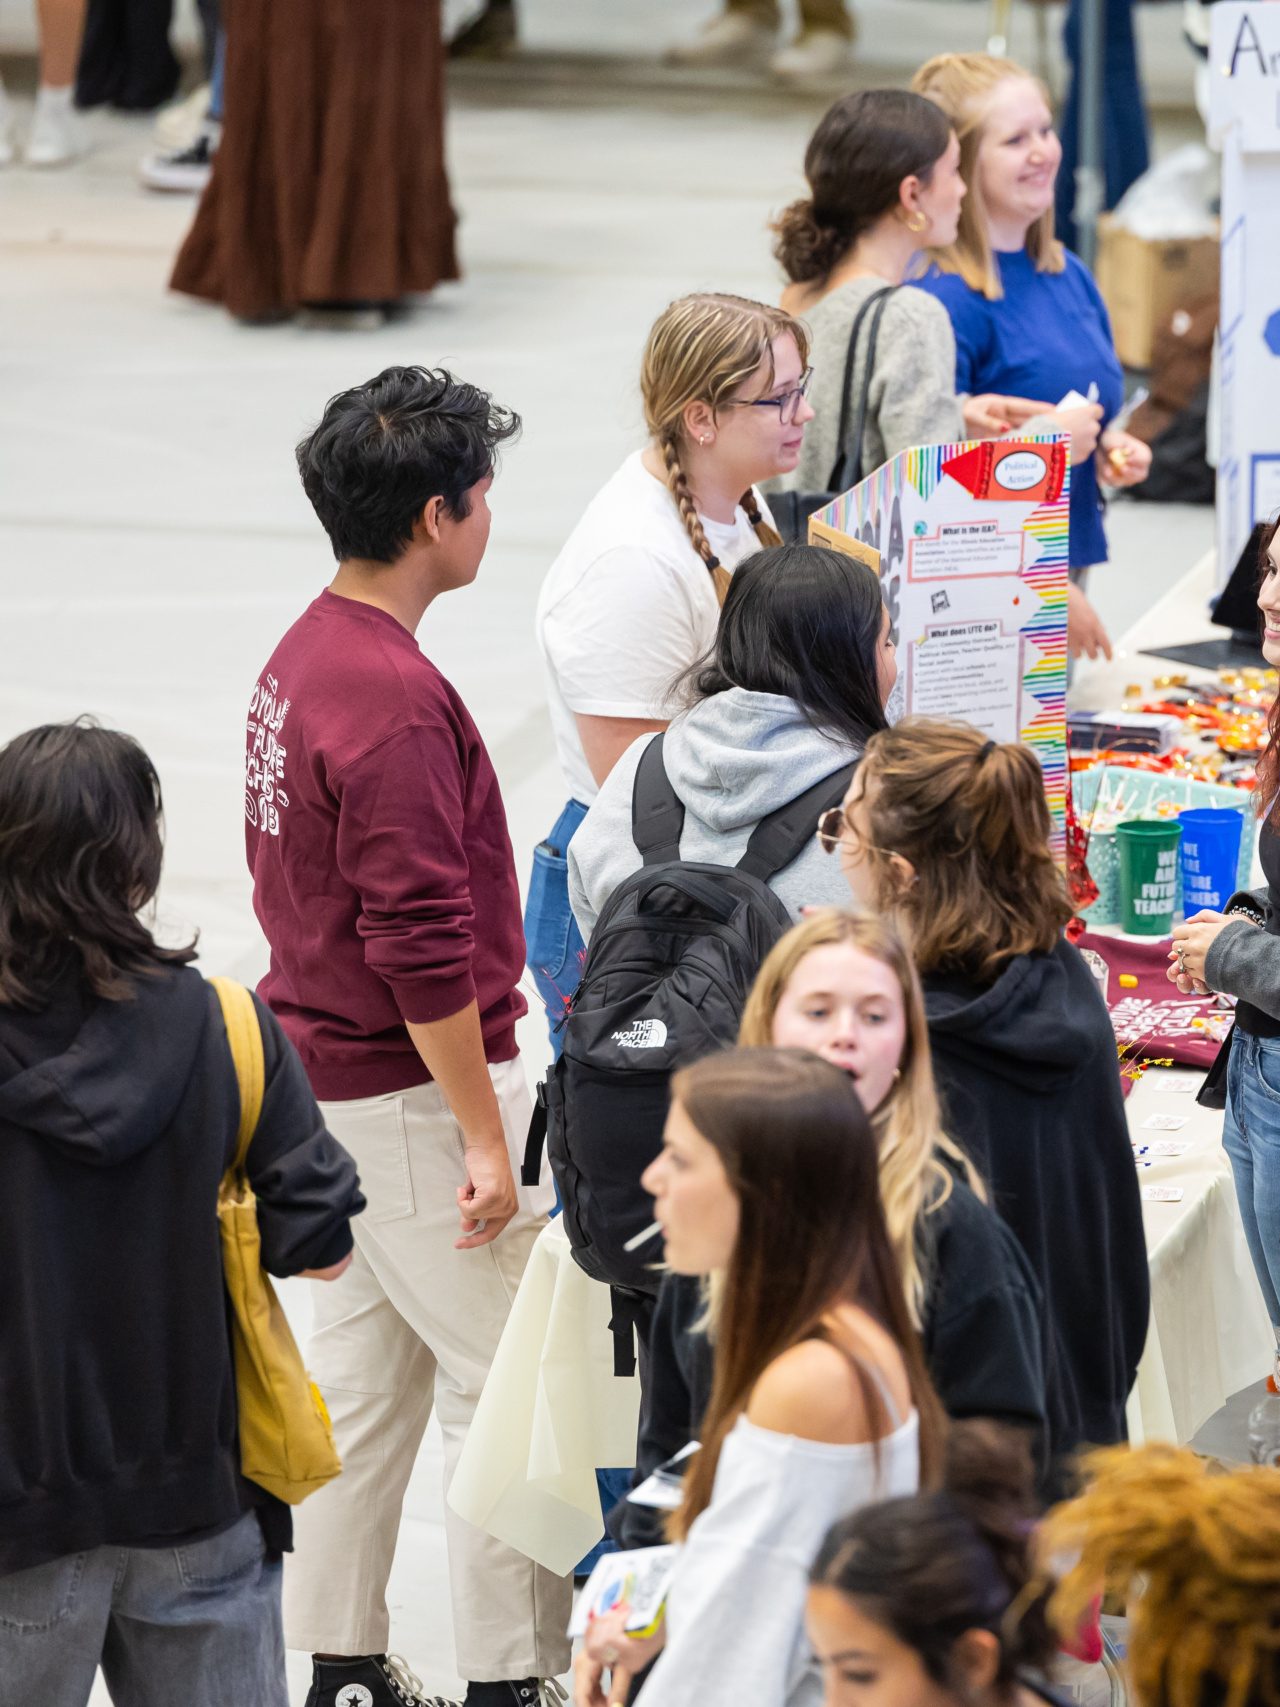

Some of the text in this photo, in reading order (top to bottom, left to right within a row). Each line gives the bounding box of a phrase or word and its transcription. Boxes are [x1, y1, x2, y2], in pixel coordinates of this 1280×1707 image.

[632, 1020, 652, 1032] THE
[611, 1031, 651, 1040] NORTH
[617, 1040, 648, 1048] FACE
